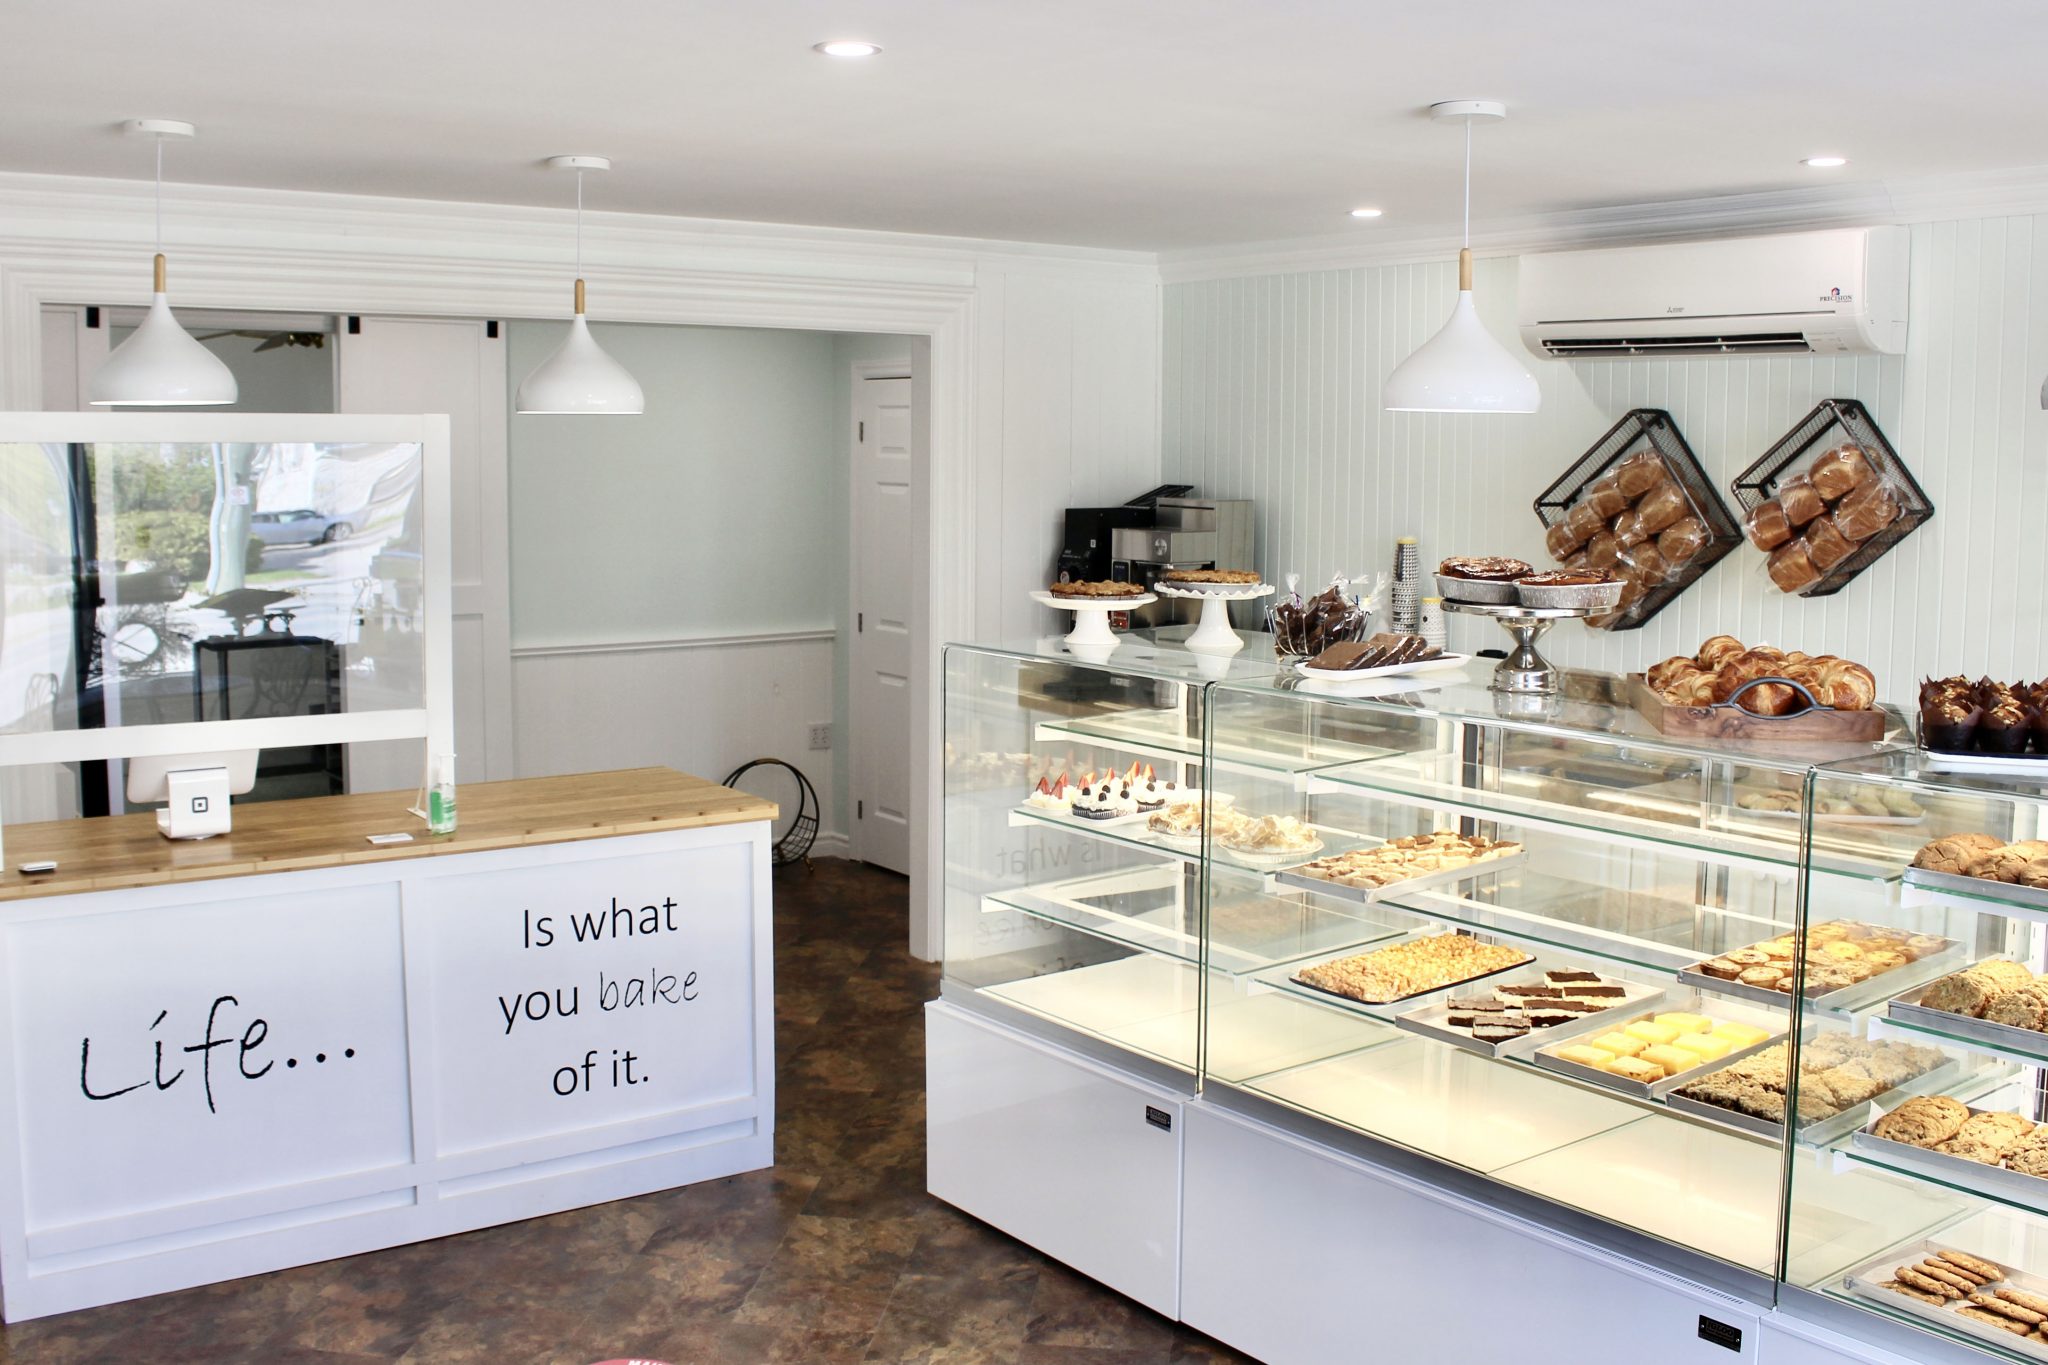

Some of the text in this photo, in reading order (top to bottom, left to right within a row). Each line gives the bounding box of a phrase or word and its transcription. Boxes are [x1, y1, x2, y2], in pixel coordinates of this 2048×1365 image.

[524, 896, 679, 949] Is what
[498, 967, 699, 1035] you bake
[80, 995, 359, 1114] Life...
[552, 1049, 649, 1096] of it.
